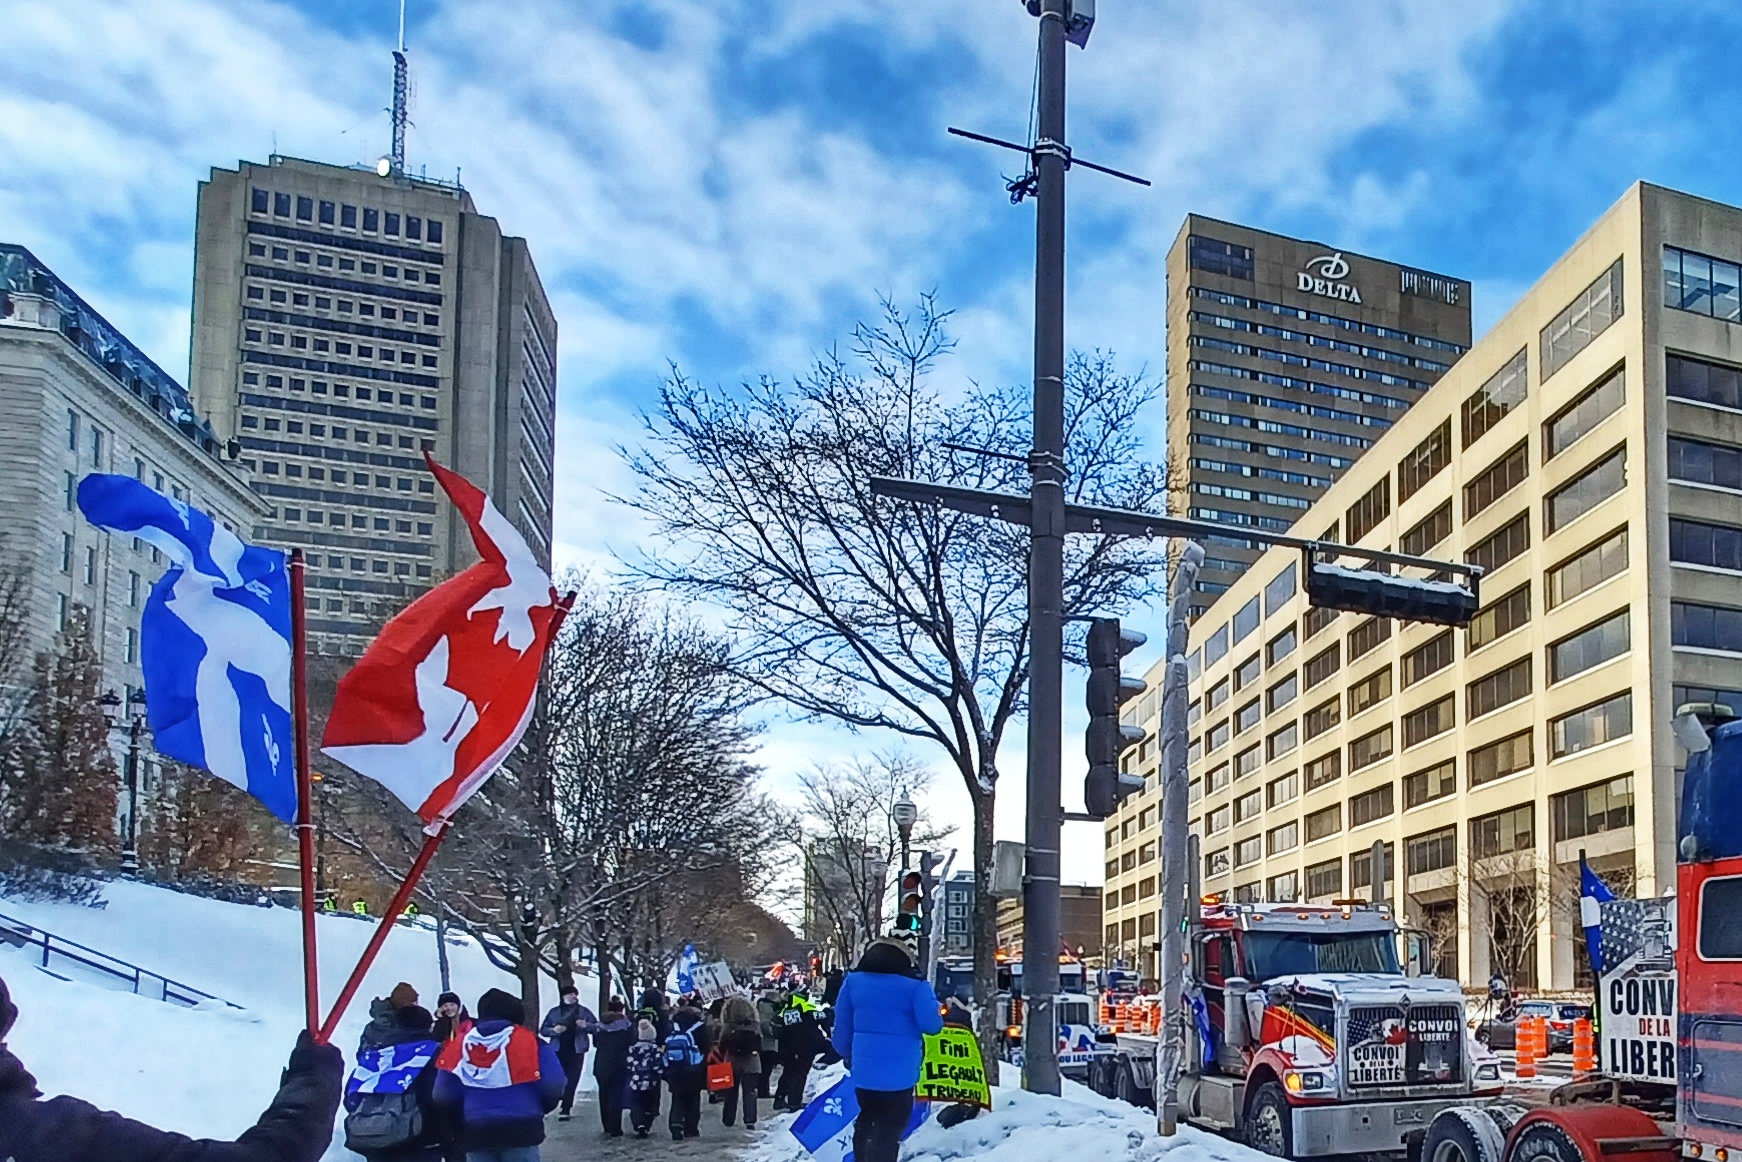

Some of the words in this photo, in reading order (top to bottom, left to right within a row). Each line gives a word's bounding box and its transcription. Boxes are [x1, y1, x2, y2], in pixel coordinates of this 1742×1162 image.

[1297, 271, 1362, 304] DELTA
[1610, 978, 1675, 1016] CONV
[1408, 1019, 1459, 1032] CONVOI
[1638, 1018, 1653, 1035] DE
[1656, 1018, 1670, 1036] LA
[1353, 1046, 1400, 1061] CONVOI
[1610, 1038, 1675, 1078] LIBER
[1351, 1064, 1401, 1082] LIBERTÉ
[922, 1083, 982, 1099] TRUDEAU
